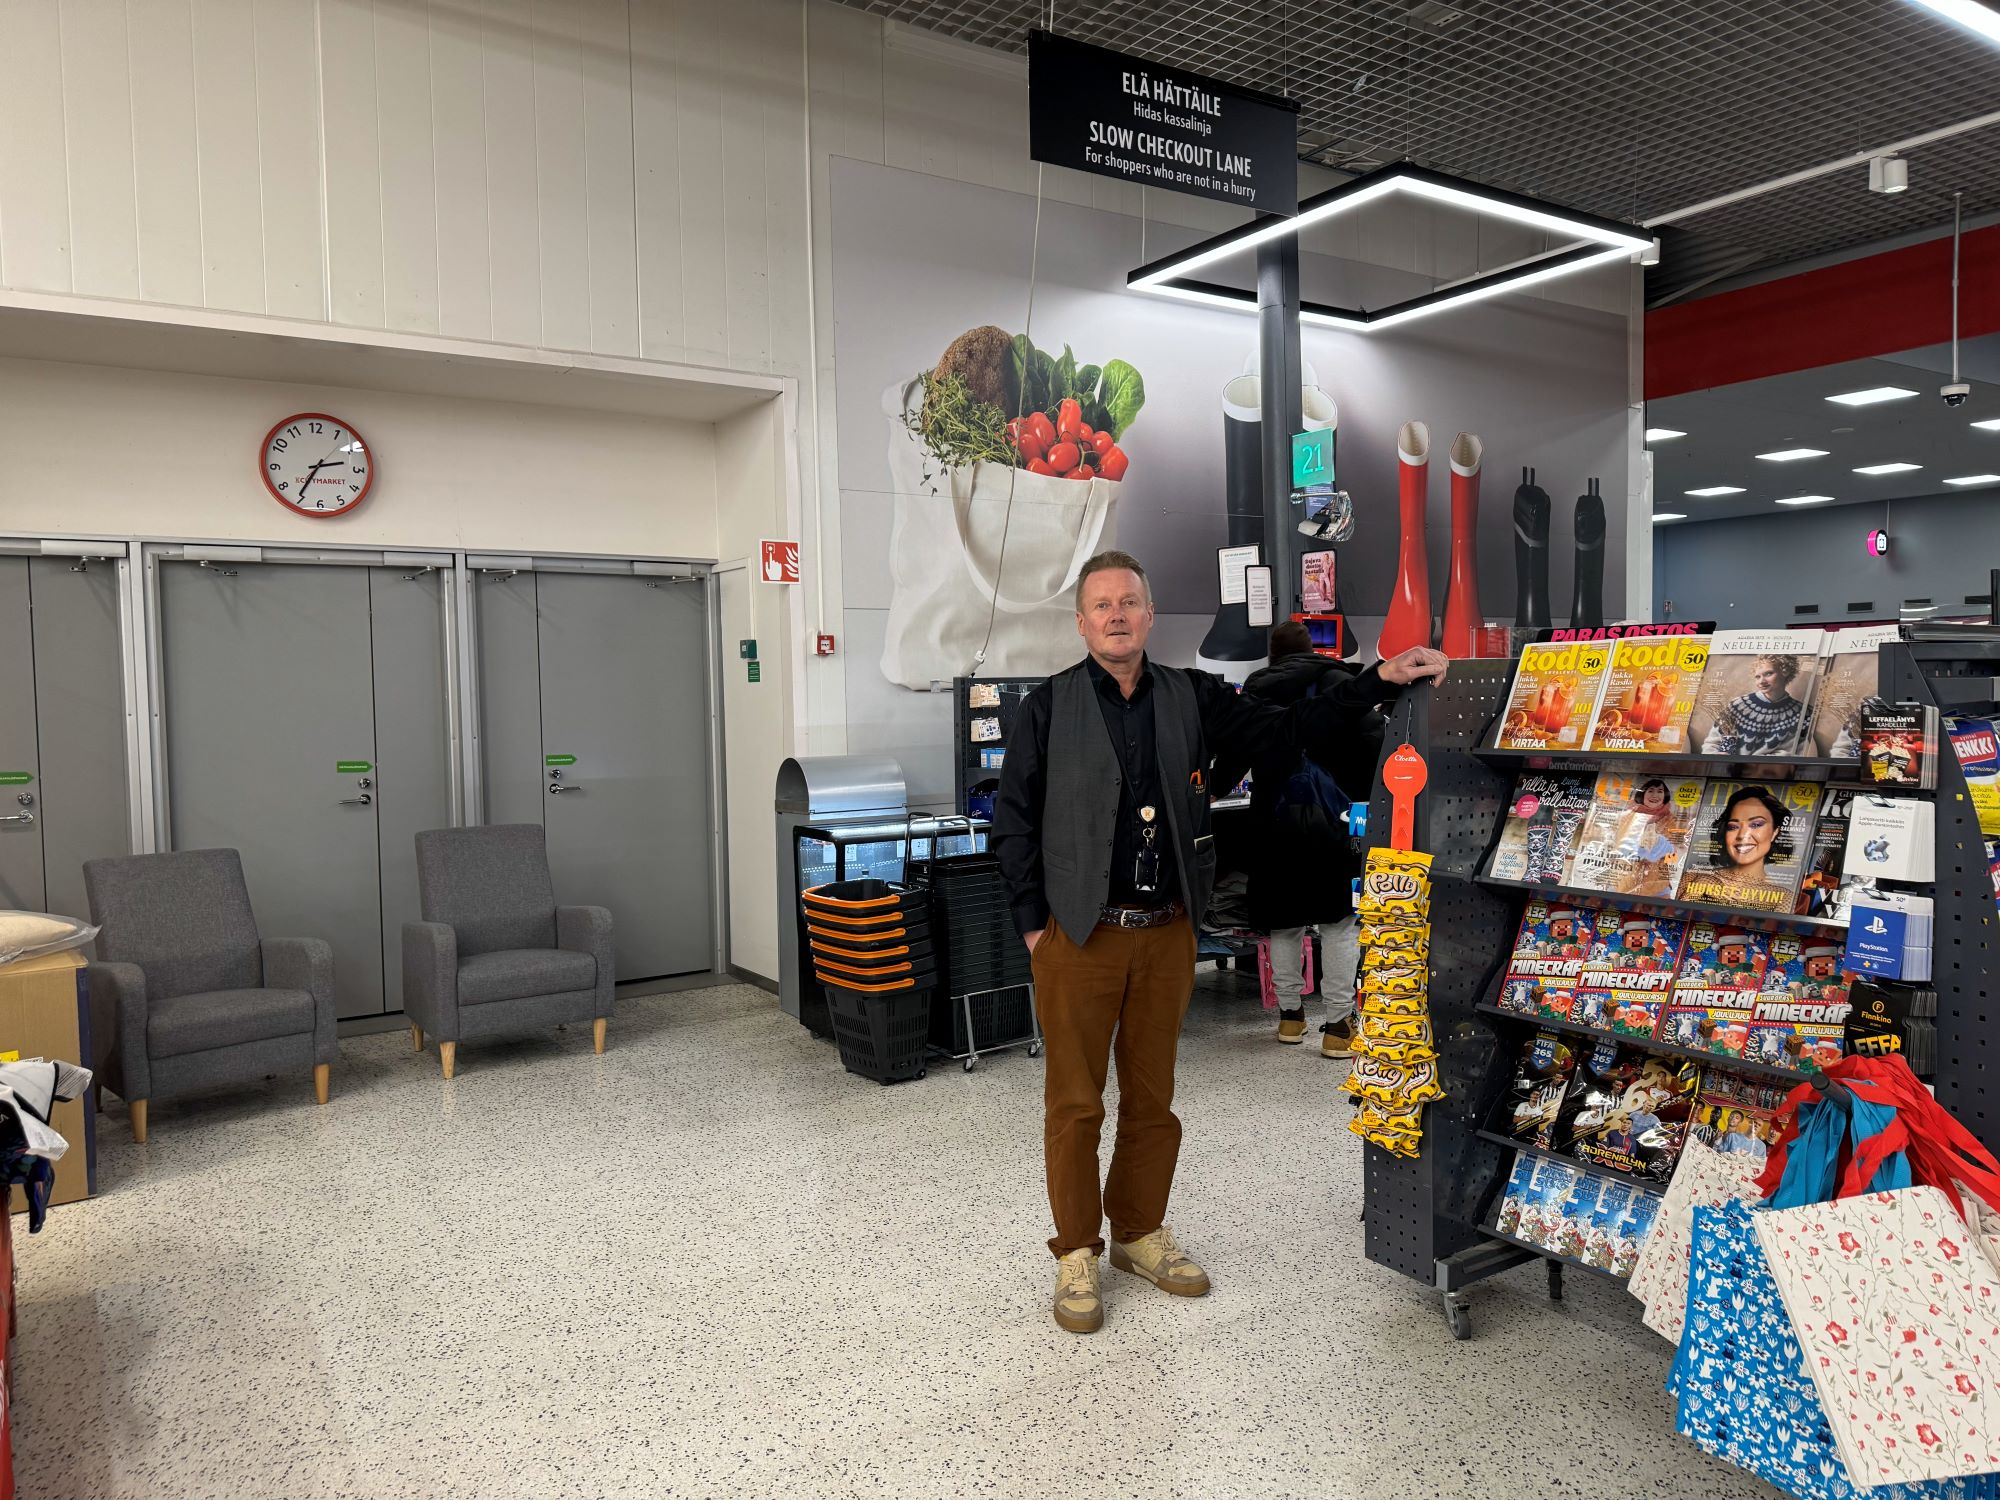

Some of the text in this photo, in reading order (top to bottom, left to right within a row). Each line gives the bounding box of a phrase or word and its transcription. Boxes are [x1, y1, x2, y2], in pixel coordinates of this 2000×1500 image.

[1122, 71, 1222, 117] ELÄ HÄTTÄILE
[1133, 101, 1212, 137] Hidas kassalinja
[1089, 120, 1252, 178] SLOW CHECKOUT LANE
[1085, 146, 1256, 202] For shoppers who are not in a hurry
[286, 425, 302, 439] 11
[308, 422, 323, 434] 12
[333, 429, 341, 440] 1
[272, 438, 288, 454] 10
[1302, 443, 1324, 474] 21
[269, 463, 281, 471] 9
[352, 466, 365, 474] 3
[278, 481, 289, 491] 8
[349, 484, 360, 493] 4
[296, 495, 306, 505] 7
[316, 499, 325, 509] 6
[336, 494, 345, 506] 5
[1551, 623, 1699, 642] PARAS OSTOS
[1722, 641, 1807, 650] NEULELEHTI
[1583, 657, 1601, 669] 50
[1683, 653, 1704, 665] 50
[1574, 702, 1592, 713] 101
[1675, 701, 1692, 713] 10
[1868, 715, 1916, 723] LEFFAELÄMYS
[1511, 738, 1546, 748] VIRTAA
[1605, 738, 1645, 750] VIRTAA
[1782, 815, 1806, 827] SITA
[1369, 872, 1418, 896] Polly
[1687, 882, 1785, 904] HIUKSET HYVIN!
[1527, 905, 1547, 919] 132
[1597, 915, 1619, 929] 132
[1690, 930, 1714, 943] 132
[1773, 940, 1800, 956] 132
[1859, 942, 1889, 952] PlayStation
[1579, 972, 1674, 991] MINECRAFT
[1753, 1003, 1853, 1024] MINECRAF
[1861, 1011, 1892, 1024] Finnkino
[1536, 1039, 1553, 1049] FIFA
[1534, 1047, 1553, 1058] 365
[1595, 1045, 1614, 1056] FIFA
[1592, 1053, 1612, 1064] 365
[1581, 1144, 1647, 1169] ADRENALYN
